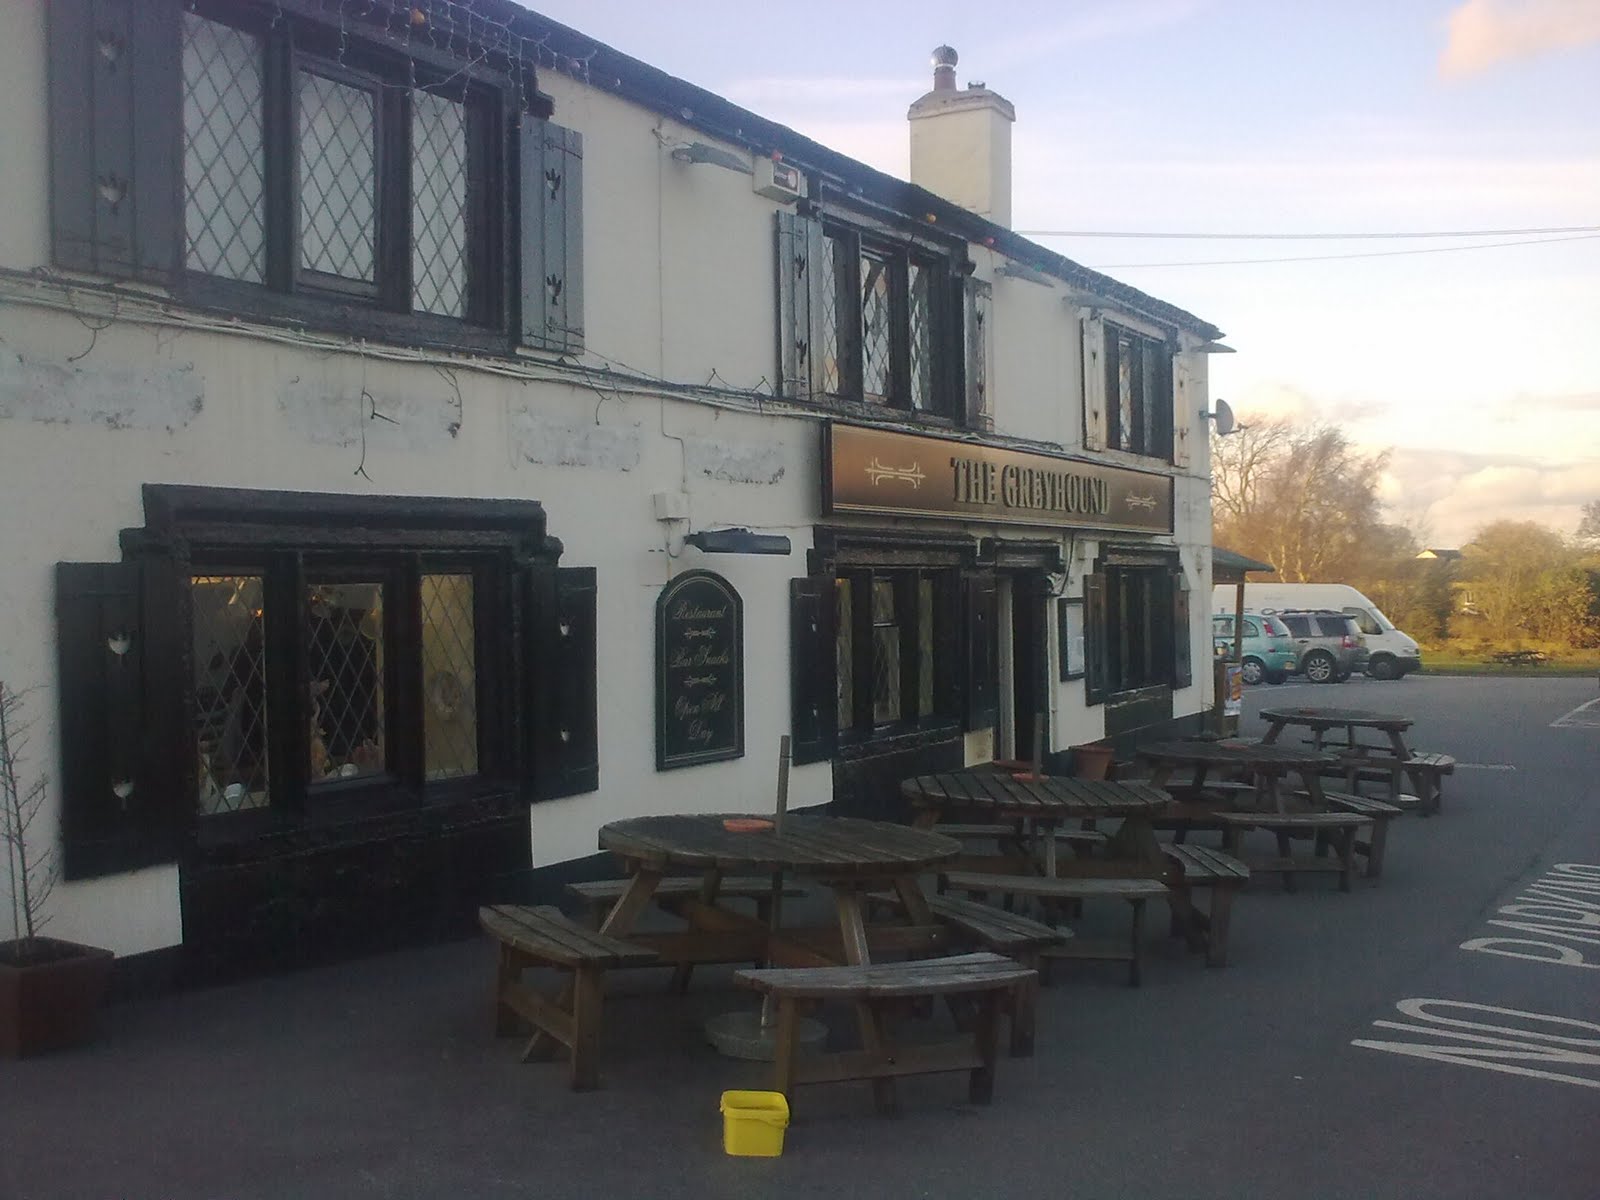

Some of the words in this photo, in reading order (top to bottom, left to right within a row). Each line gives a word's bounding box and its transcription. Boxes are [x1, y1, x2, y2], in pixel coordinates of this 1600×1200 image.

[950, 457, 998, 504] THE
[1001, 464, 1111, 515] GREYHOUND
[672, 600, 726, 619] Restaurant
